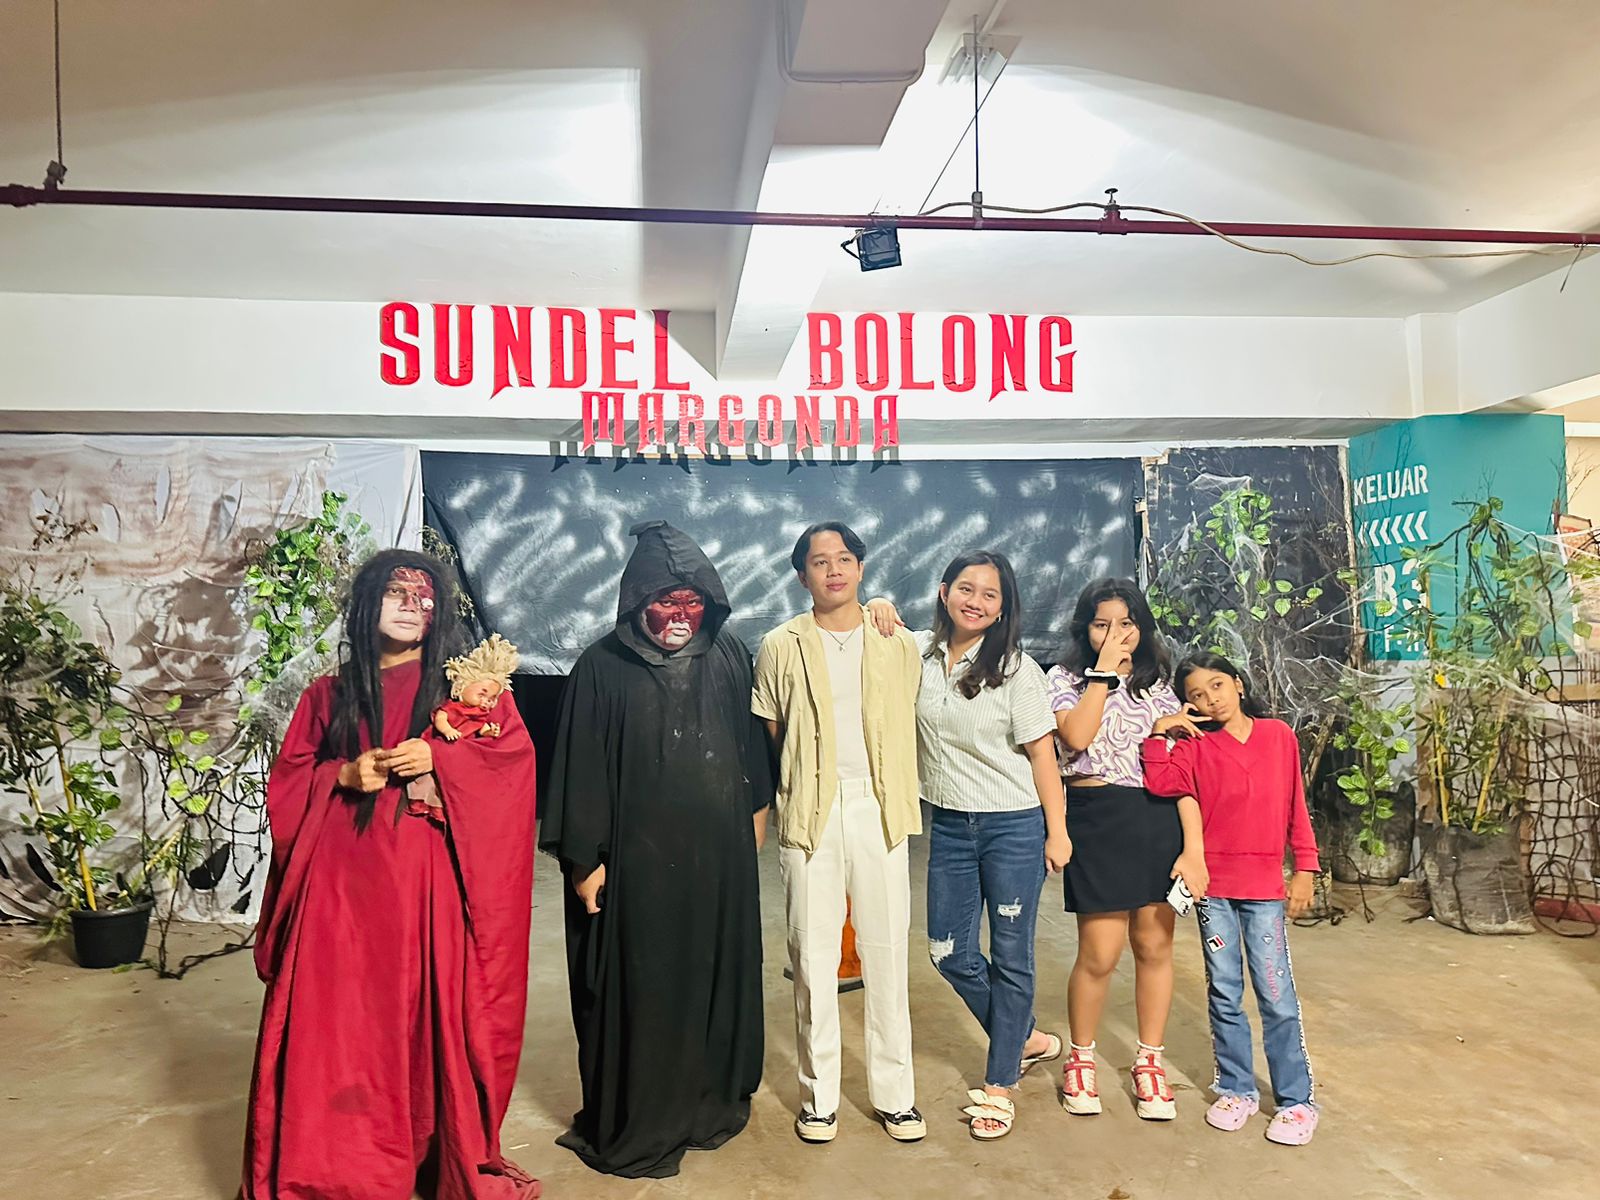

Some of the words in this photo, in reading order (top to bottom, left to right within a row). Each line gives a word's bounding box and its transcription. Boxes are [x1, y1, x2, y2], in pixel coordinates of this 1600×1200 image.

[380, 301, 690, 399] SUNDEL
[807, 312, 1078, 402] BOLONG
[581, 391, 899, 454] MARGONDA
[1354, 464, 1429, 506] KELUAR
